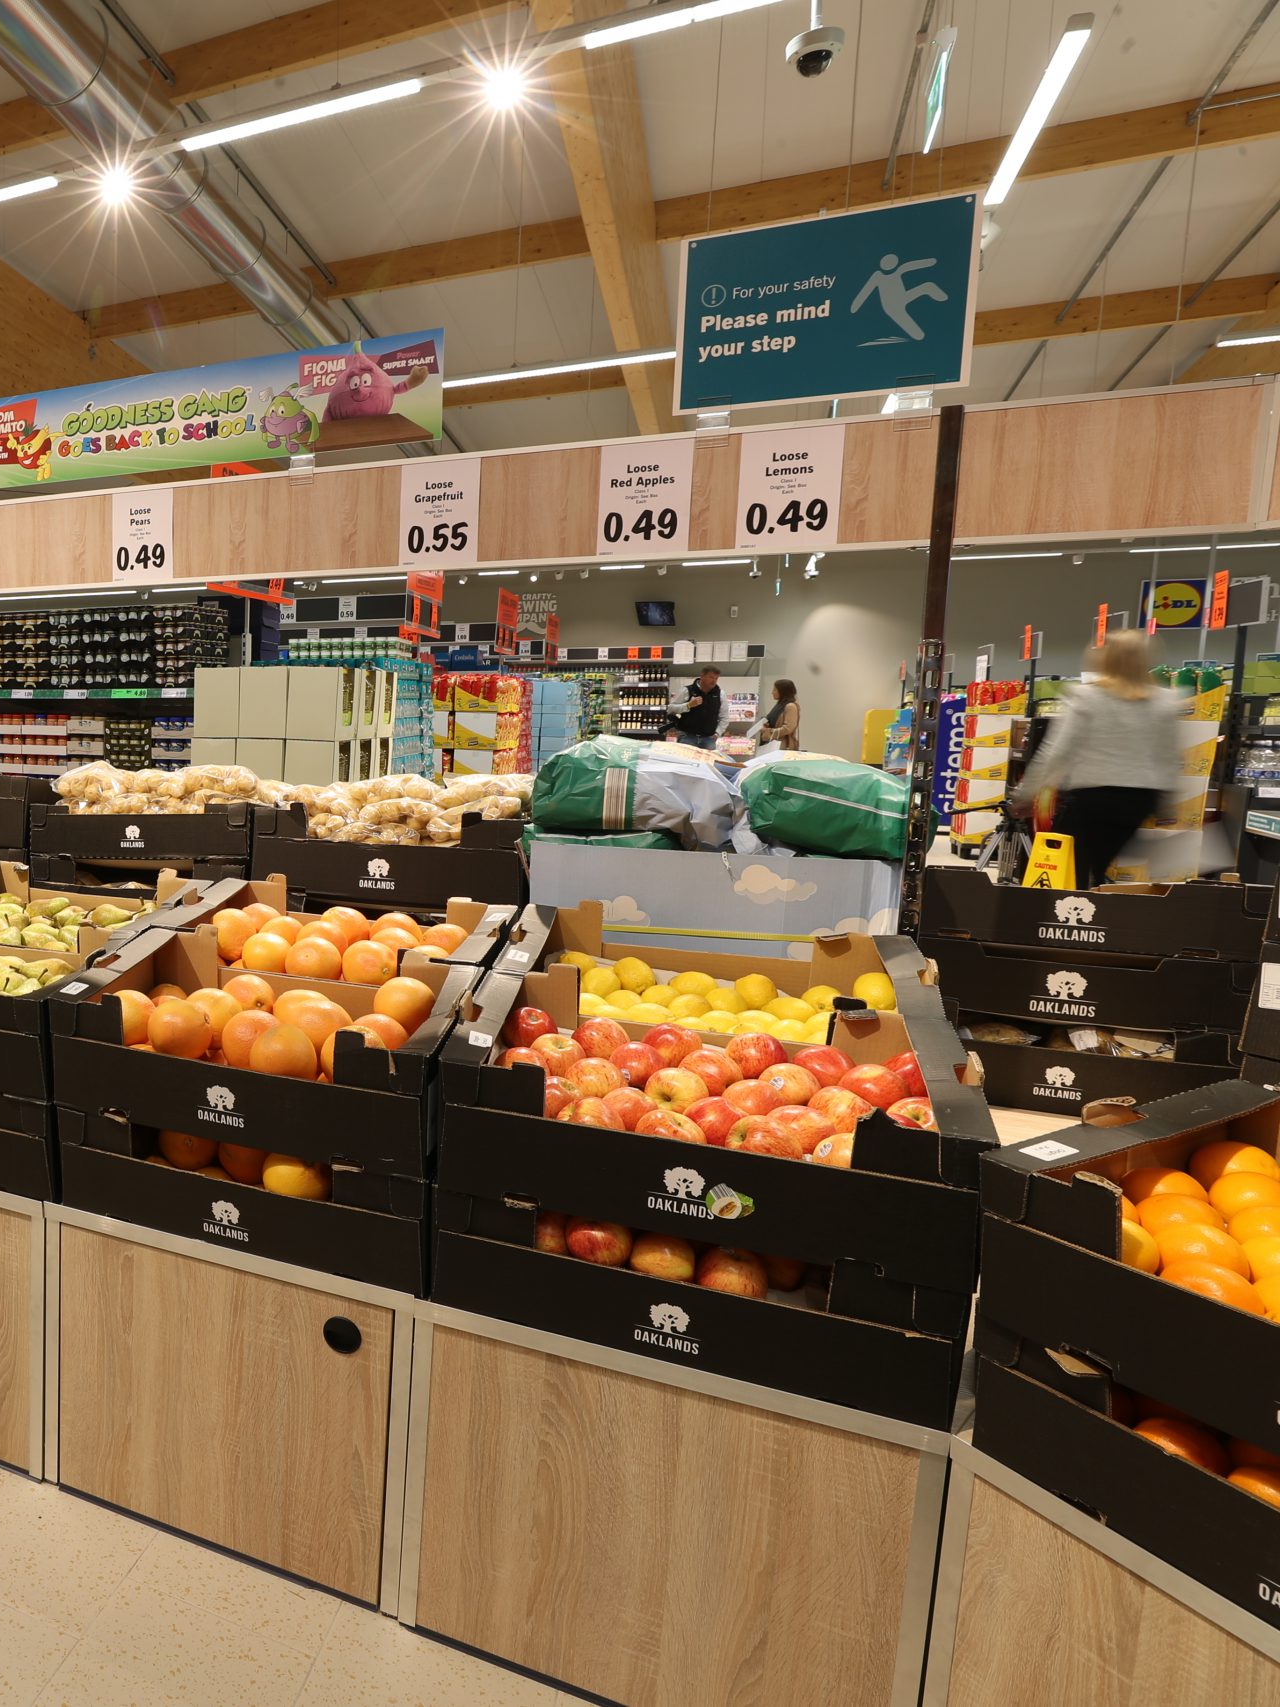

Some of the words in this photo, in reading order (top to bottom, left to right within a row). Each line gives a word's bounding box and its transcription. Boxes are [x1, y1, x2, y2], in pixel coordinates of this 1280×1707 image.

[732, 287, 754, 299] For
[758, 282, 789, 298] your
[793, 274, 836, 290] safety
[700, 312, 768, 333] Please
[776, 300, 831, 323] mind
[698, 341, 745, 363] your
[751, 335, 796, 353] step
[303, 358, 346, 376] FIONA
[382, 360, 407, 370] SUPER
[407, 355, 435, 366] SMART
[313, 373, 337, 388] FIG
[62, 399, 174, 437] GOODNESS
[178, 387, 247, 420] GANG
[58, 437, 102, 458] GOES
[105, 429, 153, 451] BACK
[156, 427, 180, 446] TO
[182, 414, 256, 441] SCHOOL
[772, 452, 809, 463] Loose
[626, 463, 660, 474] Loose
[765, 465, 814, 477] Lemons
[425, 481, 454, 490] Loose
[610, 478, 632, 489] Red
[636, 475, 675, 488] Apples
[414, 491, 464, 504] Grapefruit
[129, 507, 152, 516] Loose
[746, 498, 828, 535] 0.49
[130, 518, 151, 527] Pears
[603, 508, 678, 543] 0.49
[407, 521, 469, 554] 0.55
[116, 543, 165, 572] 0.49
[340, 610, 354, 619] 0.59
[518, 600, 558, 612] EWING
[280, 612, 295, 621] 0.49
[938, 711, 966, 814] sistema
[1034, 861, 1058, 871] CAUTION
[358, 879, 395, 890] OAKLANDS
[1038, 926, 1106, 944] OAKLANDS
[1029, 1000, 1096, 1018] OAKLANDS
[1032, 1086, 1082, 1101] OAKLANDS
[197, 1109, 245, 1128] OAKLANDS
[647, 1196, 715, 1220] OAKLANDS
[203, 1222, 249, 1242] OAKLANDS
[634, 1329, 700, 1355] OAKLANDS
